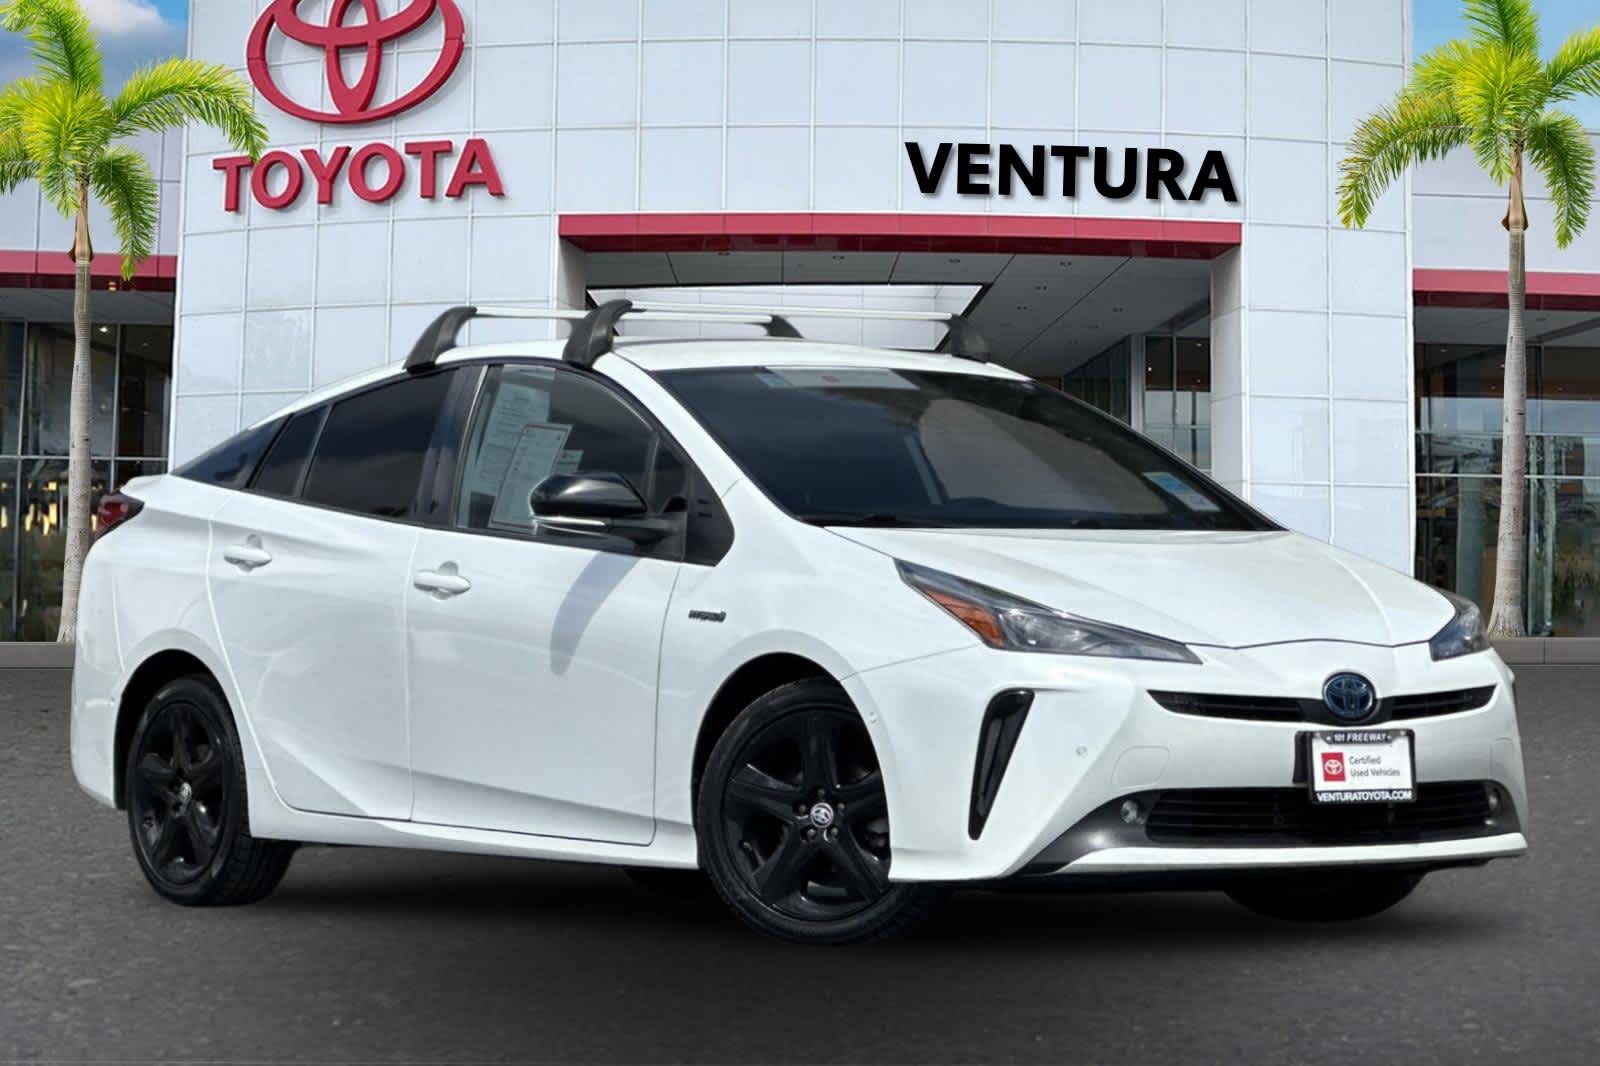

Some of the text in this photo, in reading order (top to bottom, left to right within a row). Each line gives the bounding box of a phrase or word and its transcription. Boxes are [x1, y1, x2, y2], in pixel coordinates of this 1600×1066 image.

[212, 138, 505, 212] TOYOTA
[904, 142, 1240, 203] VENTURA
[1347, 732, 1386, 741] FREEWAY
[1349, 756, 1381, 765] Certified
[1350, 768, 1400, 777] Used Vehicles
[1316, 790, 1412, 802] VENTURATOYOTA.COM
